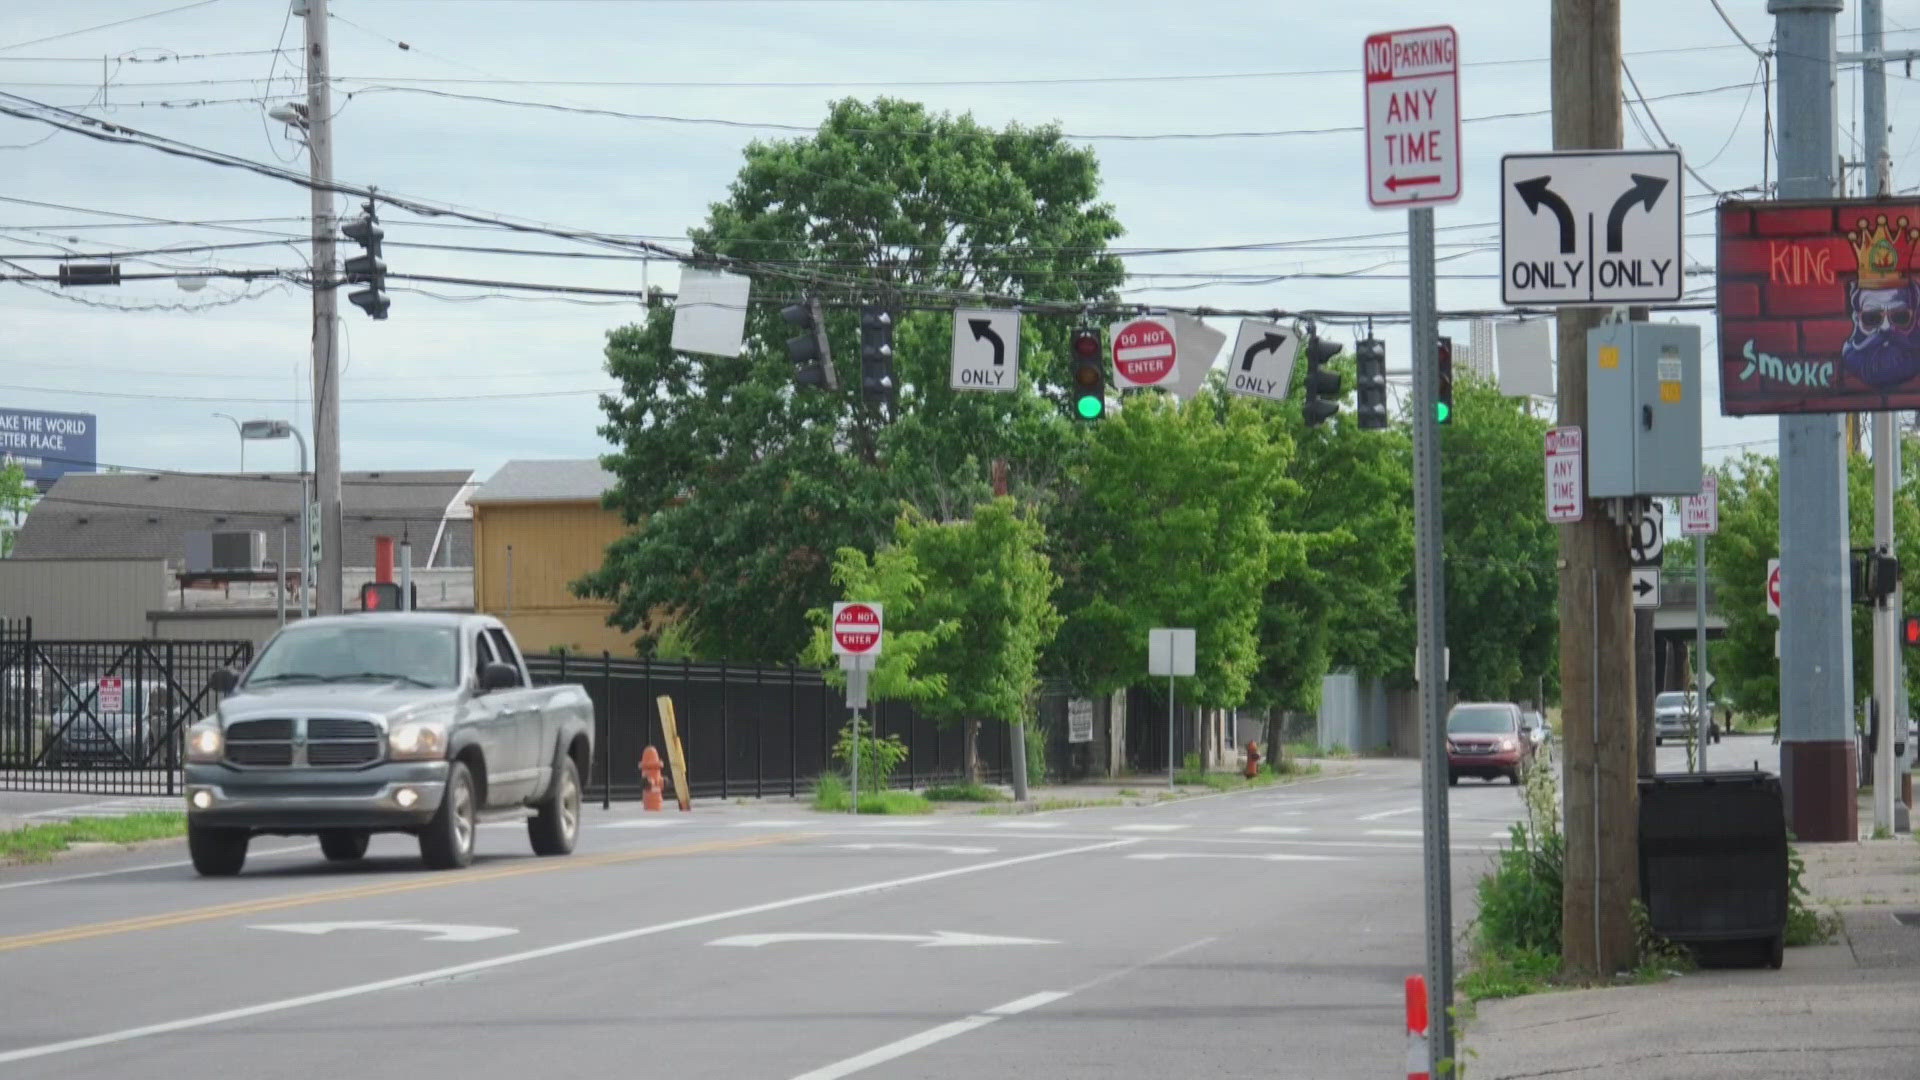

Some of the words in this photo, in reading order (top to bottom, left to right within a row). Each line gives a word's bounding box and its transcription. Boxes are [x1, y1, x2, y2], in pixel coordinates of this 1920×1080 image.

[1367, 41, 1391, 75] NO
[1394, 38, 1453, 69] PARKING
[1387, 87, 1437, 124] ANY
[1384, 130, 1442, 166] TIME
[1770, 240, 1835, 285] KING
[1512, 260, 1584, 290] ONLY
[1599, 259, 1672, 289] ONLY
[1121, 335, 1138, 347] DO
[1143, 332, 1166, 345] NOT
[1127, 360, 1164, 375] ENTER
[1739, 339, 1833, 387] Smoke
[961, 369, 1004, 385] ONLY
[1235, 374, 1276, 394] ONLY
[22, 416, 42, 432] THE
[45, 417, 86, 435] WORLD
[30, 433, 66, 451] PLACE.
[1553, 461, 1573, 478] ANY
[1553, 482, 1574, 499] TIME
[1688, 496, 1708, 506] ANY
[1688, 509, 1709, 520] TIME
[840, 611, 853, 622] DO
[857, 611, 874, 622] NOT
[842, 634, 872, 645] ENTER
